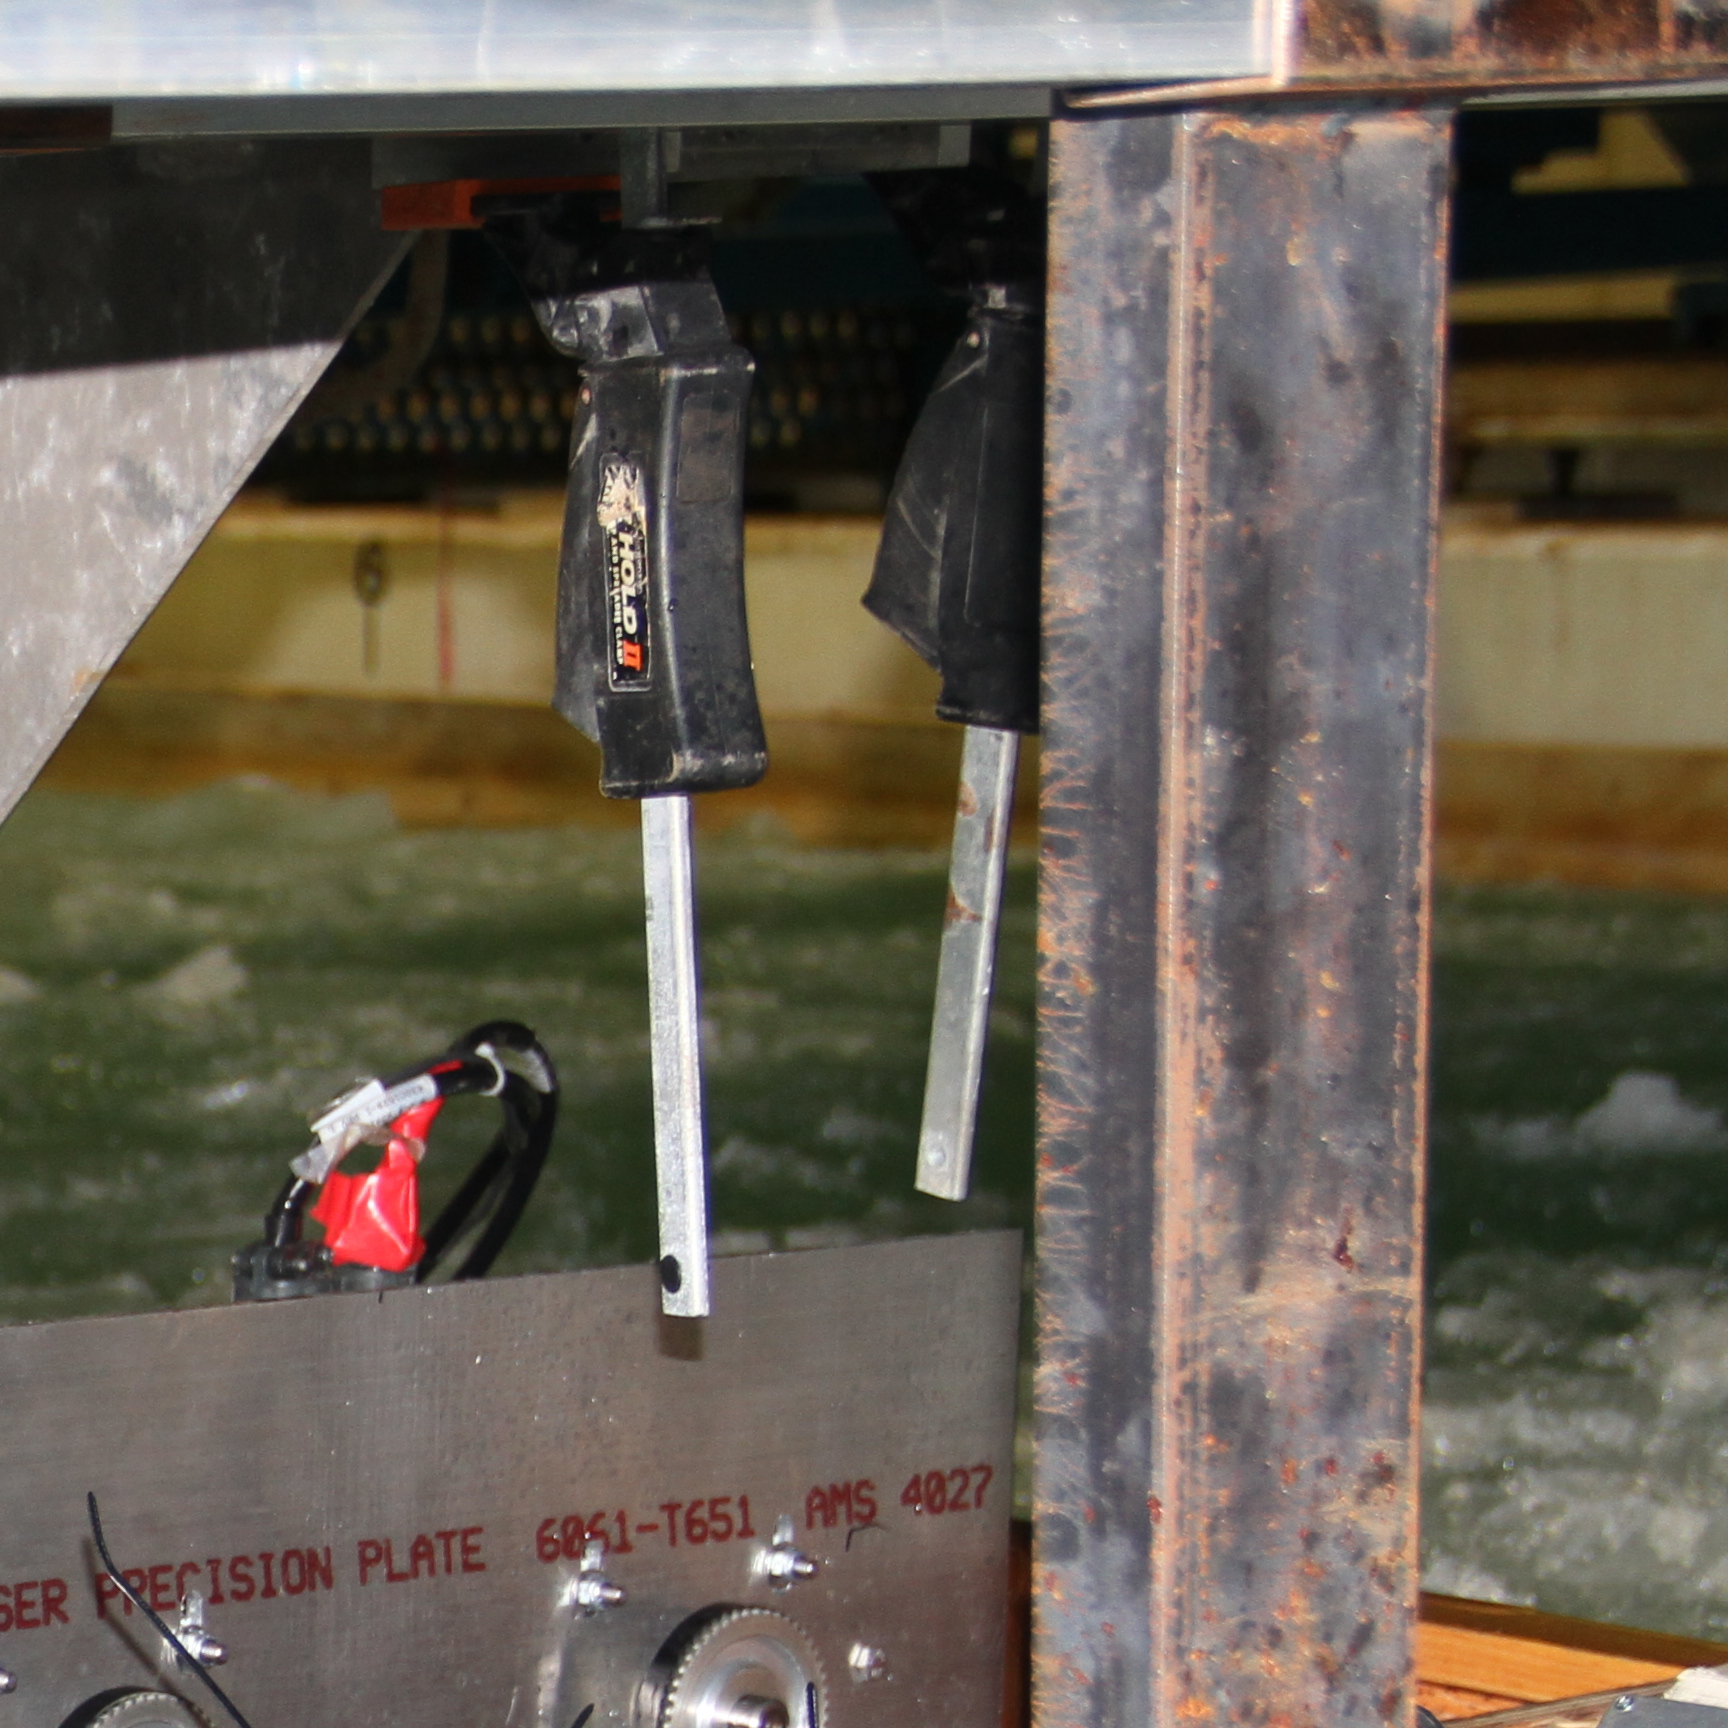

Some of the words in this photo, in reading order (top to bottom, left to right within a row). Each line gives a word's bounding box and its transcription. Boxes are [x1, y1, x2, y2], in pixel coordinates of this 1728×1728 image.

[619, 532, 637, 635] HOLD
[96, 1546, 334, 1620] PRECISION
[357, 1526, 487, 1586] PLATE
[805, 1479, 879, 1530] AMS
[899, 1464, 994, 1515] 4027
